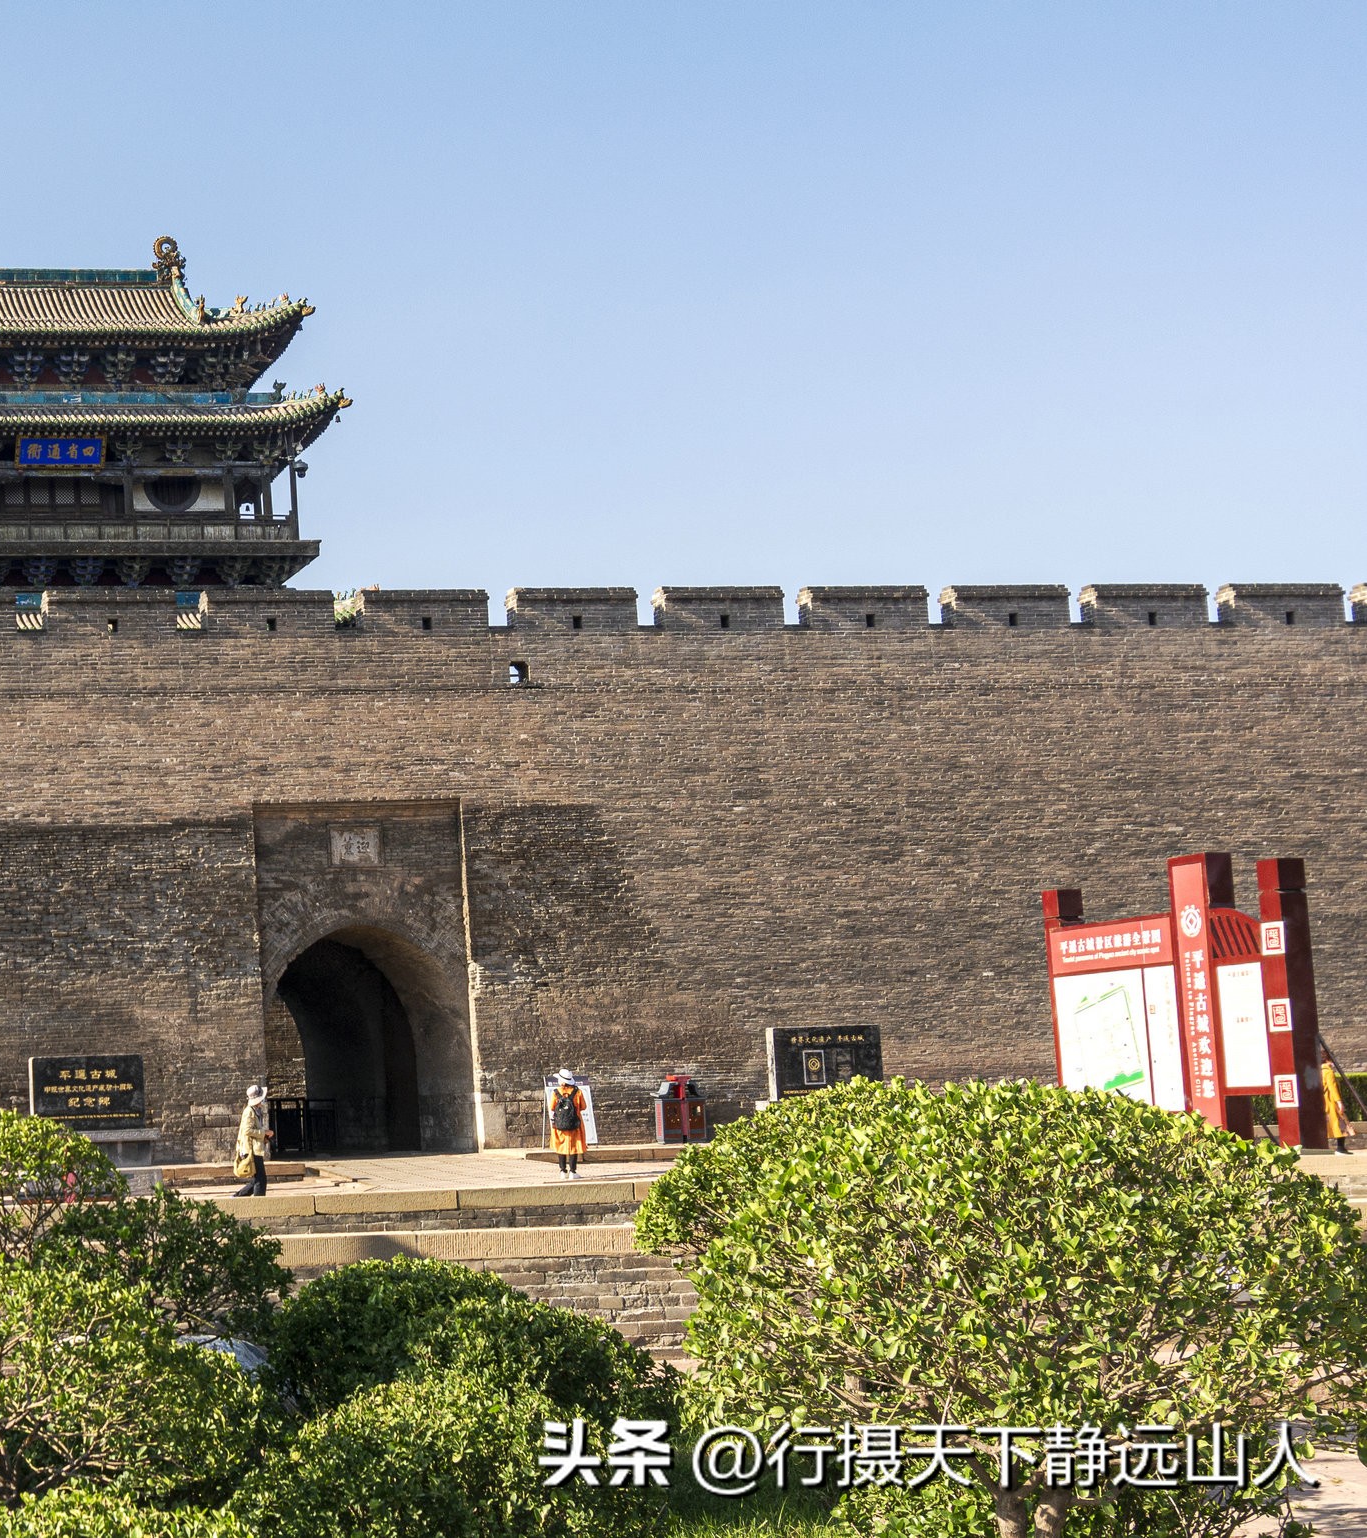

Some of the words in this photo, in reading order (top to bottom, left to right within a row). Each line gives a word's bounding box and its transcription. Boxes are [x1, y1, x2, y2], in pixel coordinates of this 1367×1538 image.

[1191, 949, 1215, 1098] 平遥古城欢迎您
[59, 1069, 117, 1081] 平遥古城
[68, 1096, 111, 1108] 纪念碑
